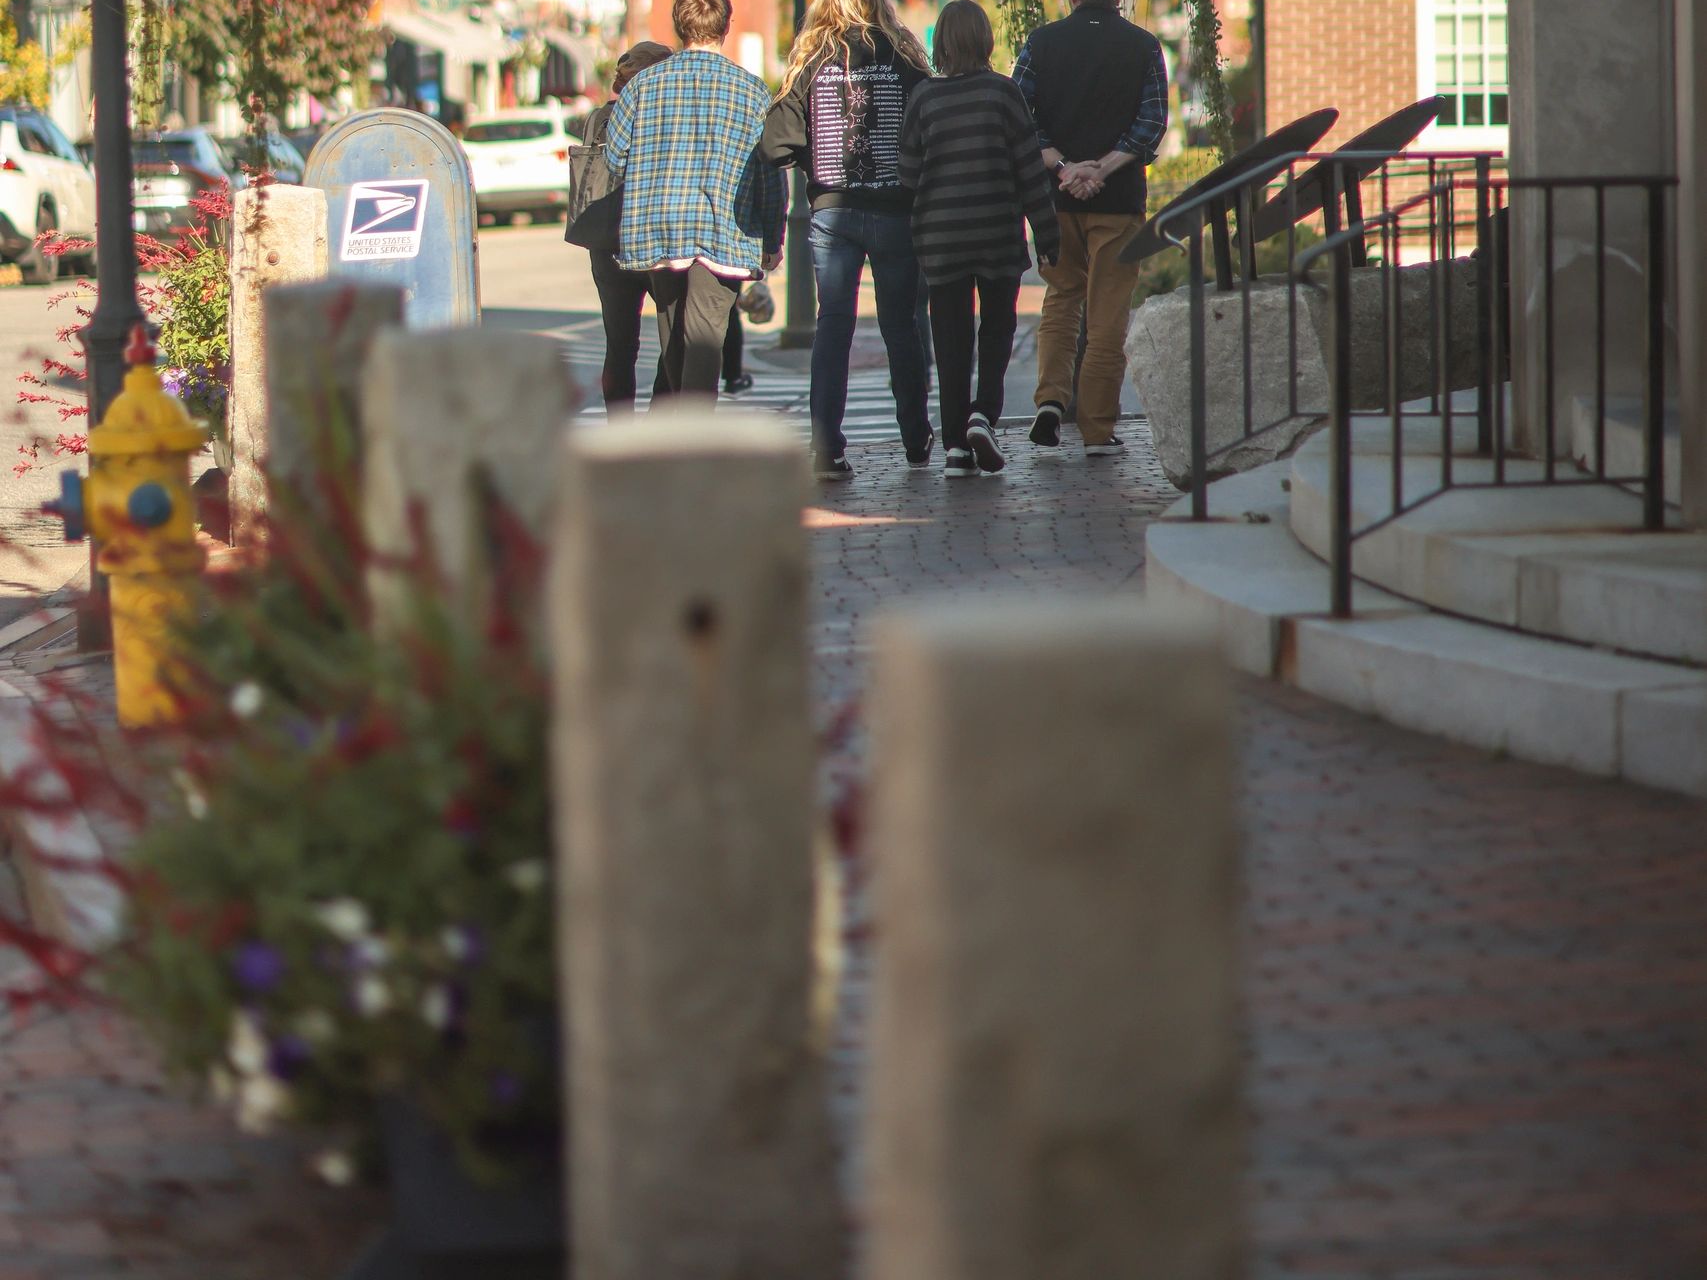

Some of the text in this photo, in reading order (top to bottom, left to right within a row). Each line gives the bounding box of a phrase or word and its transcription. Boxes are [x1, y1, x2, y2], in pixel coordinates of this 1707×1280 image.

[349, 236, 411, 246] UNITED STATES
[347, 246, 414, 255] POSTAL SERVICE
